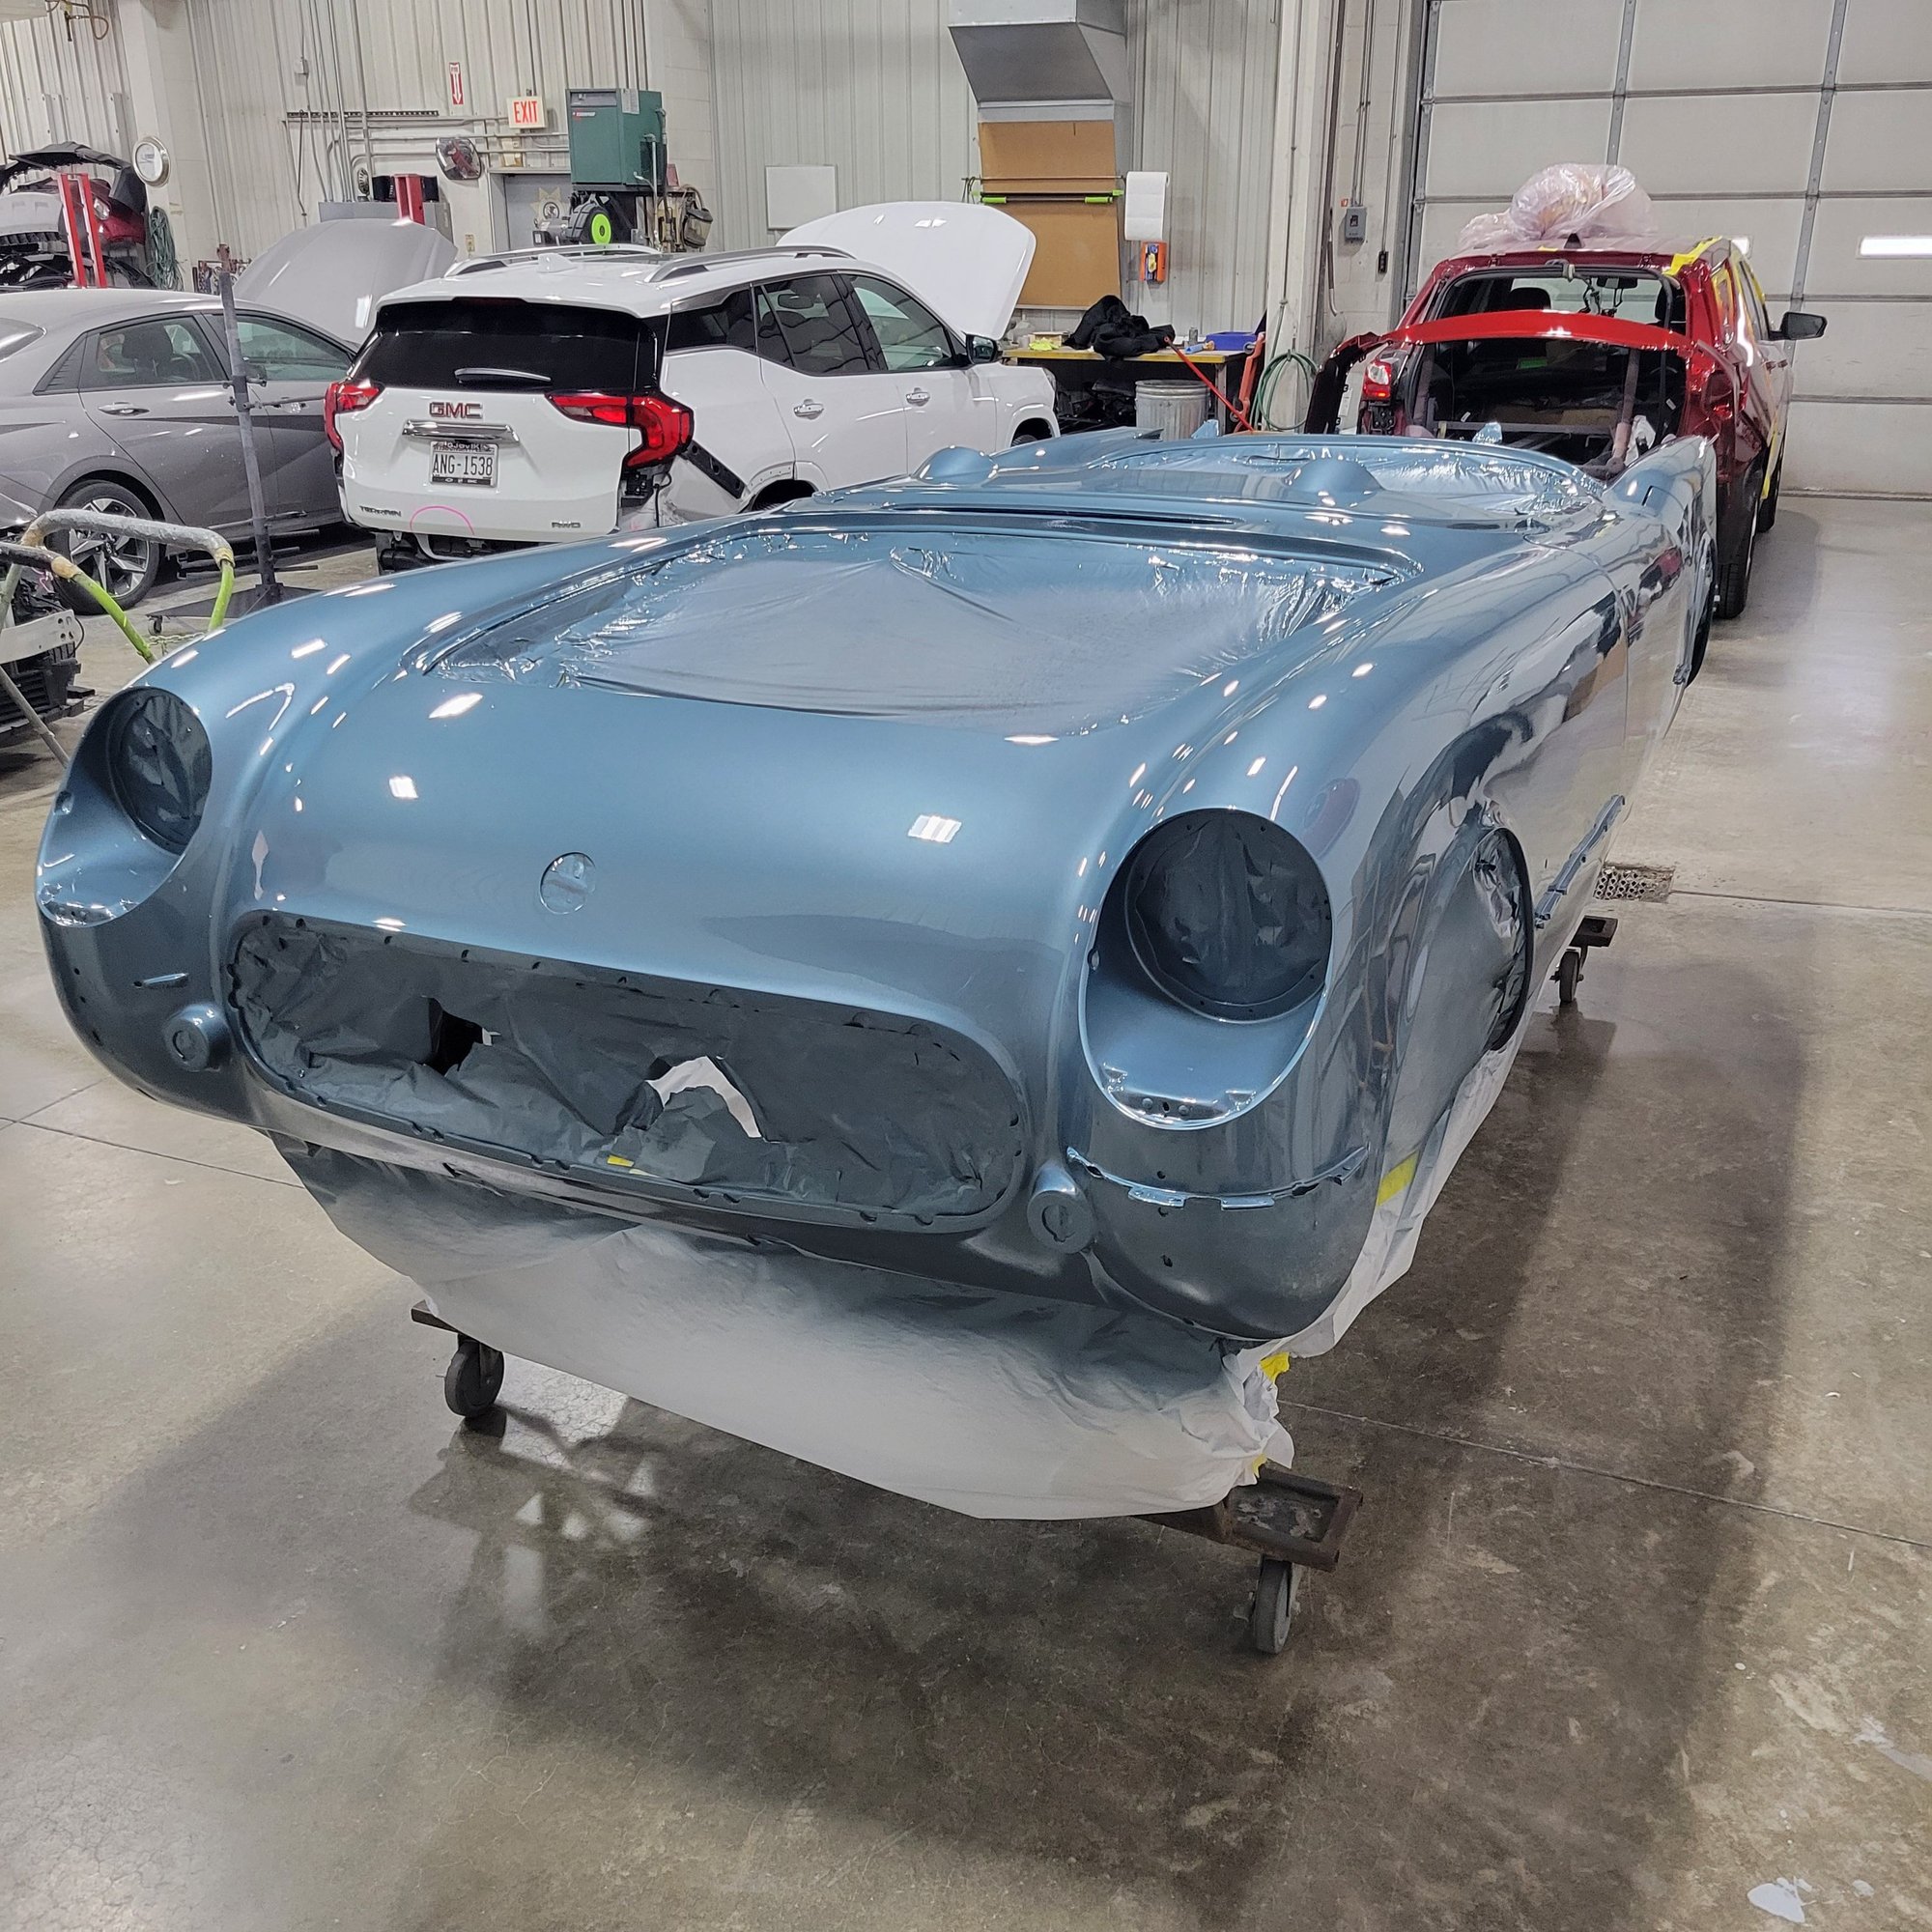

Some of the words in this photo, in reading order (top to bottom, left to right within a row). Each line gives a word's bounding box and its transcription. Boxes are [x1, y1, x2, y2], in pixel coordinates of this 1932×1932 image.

[513, 100, 538, 124] EXIT
[430, 402, 483, 418] GMC
[433, 453, 494, 476] ANG-1538
